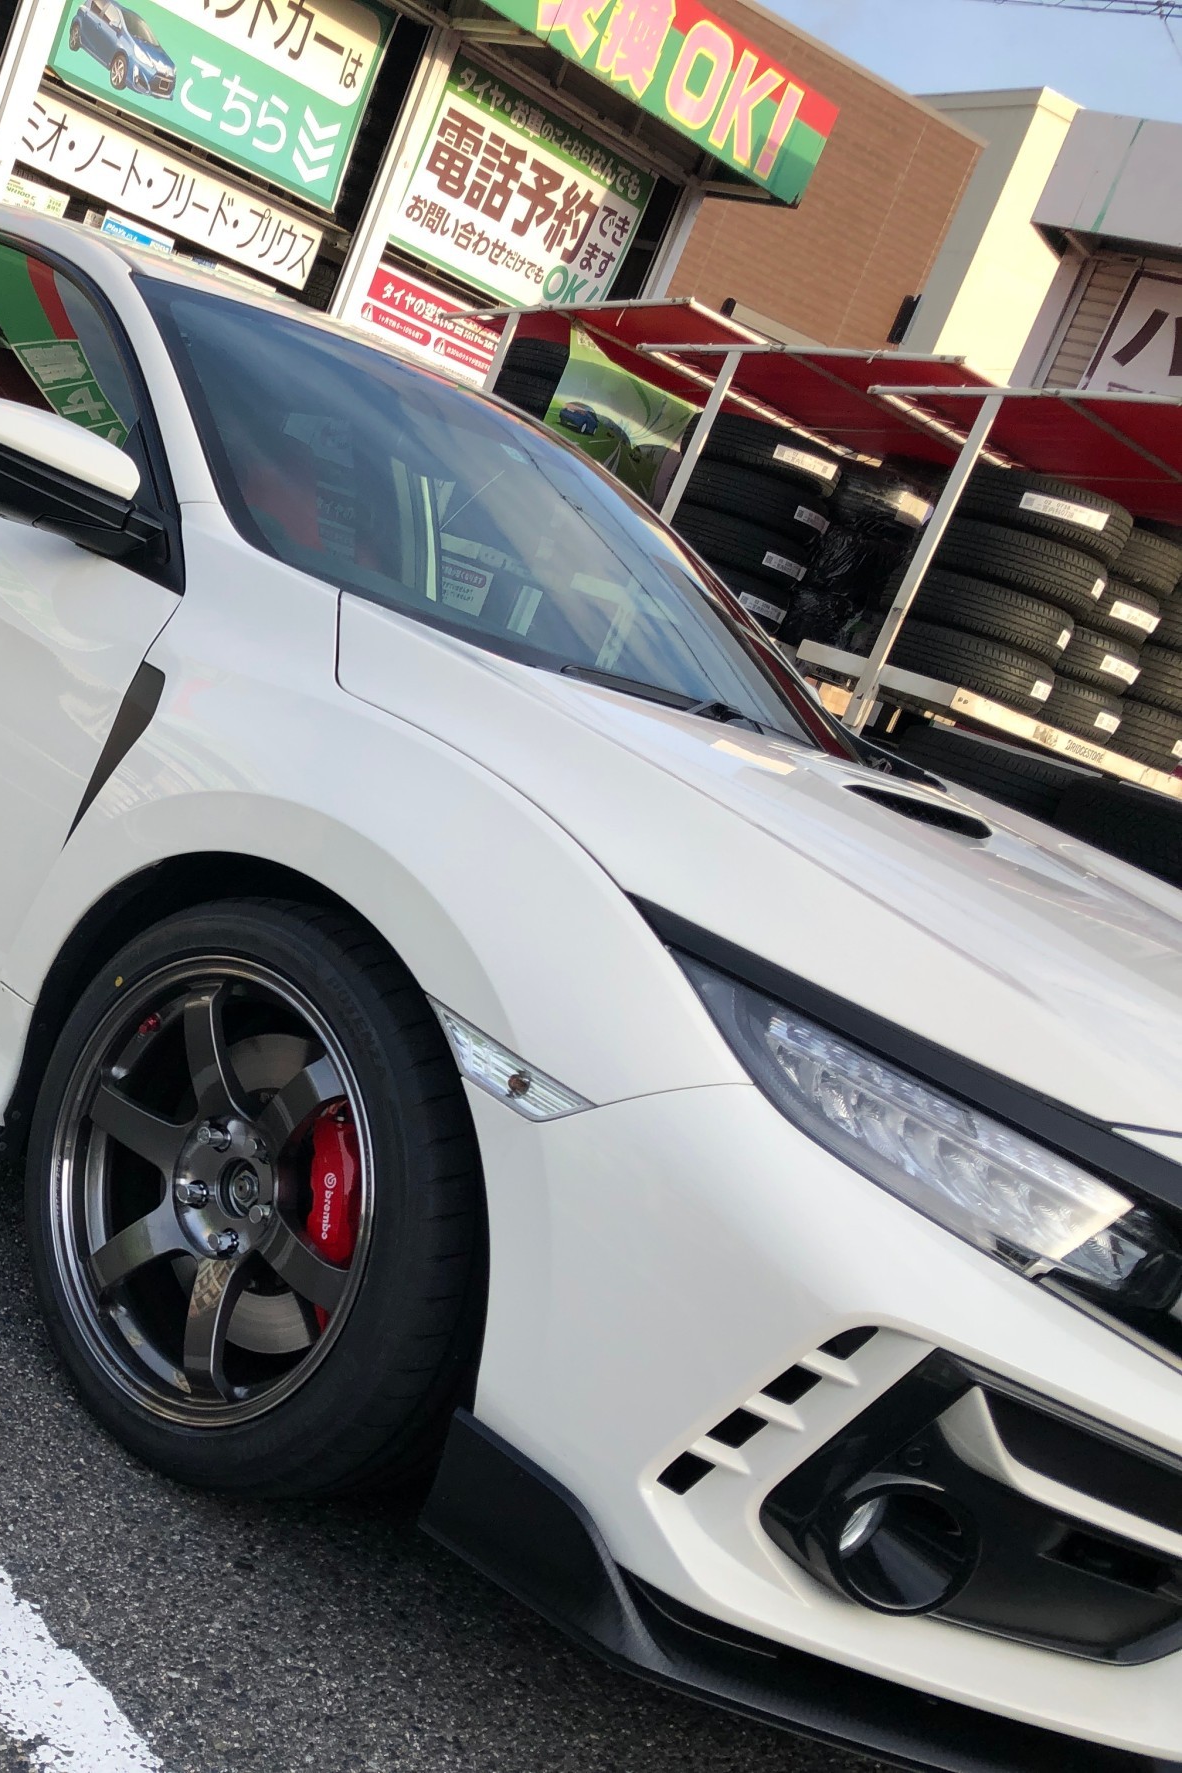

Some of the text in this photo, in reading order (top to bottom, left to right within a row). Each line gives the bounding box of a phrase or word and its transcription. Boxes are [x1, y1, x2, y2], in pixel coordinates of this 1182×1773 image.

[180, 55, 290, 154] こちら
[457, 68, 640, 200] タイヤ・お車のことならなんでも
[426, 107, 601, 264] 電話予約
[404, 194, 544, 285] お問い合わせだけでも
[1065, 739, 1105, 764] BRIDGESTONE
[320, 1189, 336, 1241] brembo
